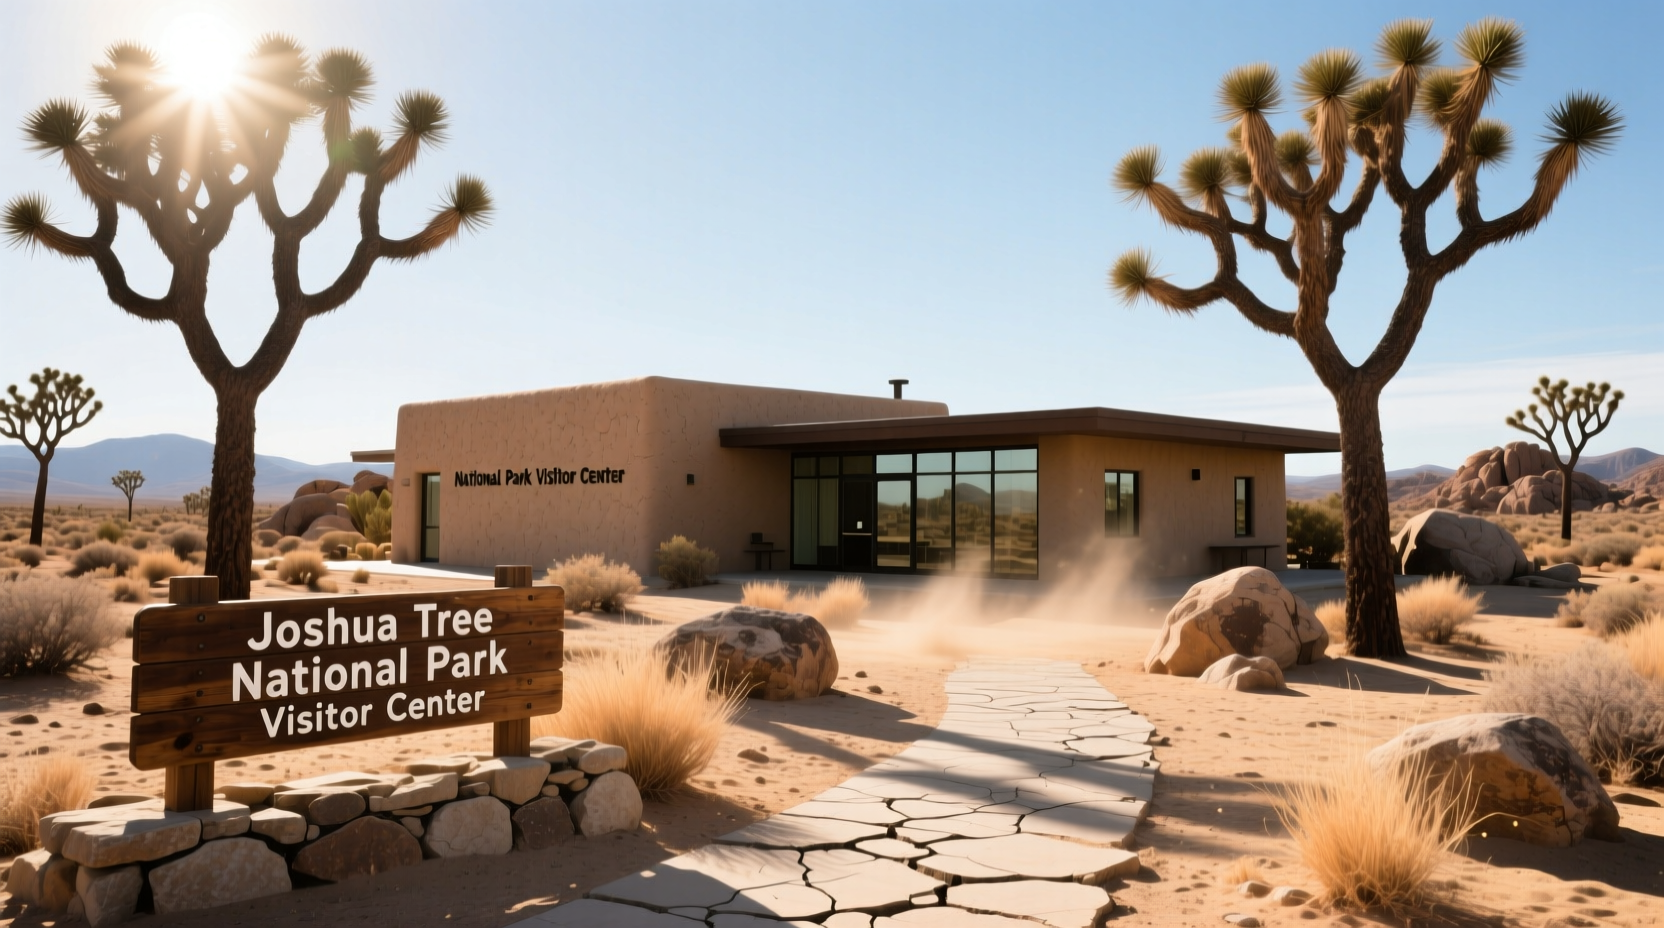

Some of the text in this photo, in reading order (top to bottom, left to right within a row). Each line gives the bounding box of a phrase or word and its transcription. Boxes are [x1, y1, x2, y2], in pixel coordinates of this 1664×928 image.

[455, 467, 625, 487] National Park Visitor Center
[247, 603, 493, 651] Joshua Tree
[232, 639, 508, 702] National Park
[260, 689, 485, 738] Visitor Center
